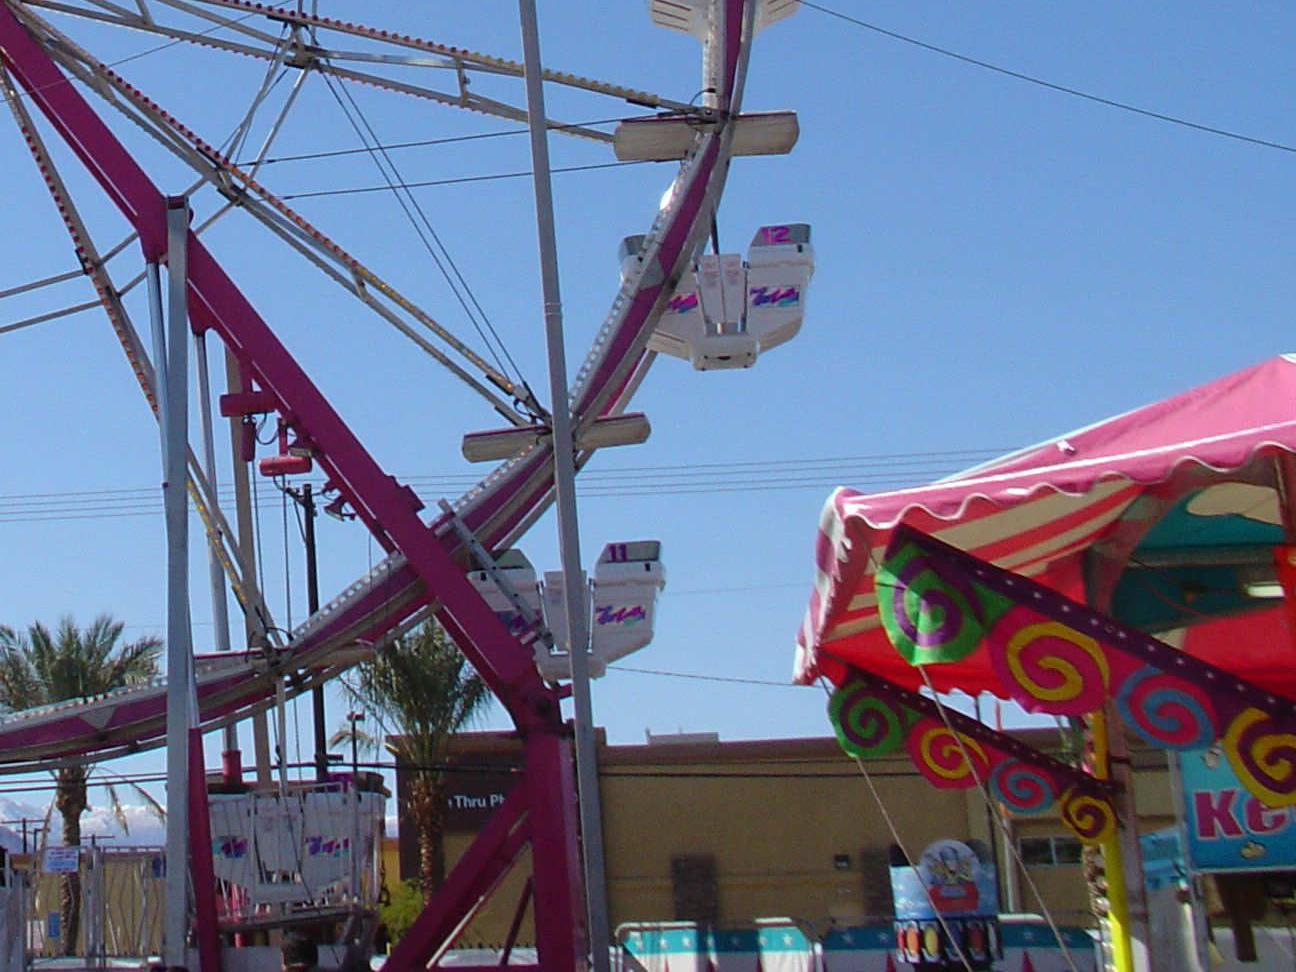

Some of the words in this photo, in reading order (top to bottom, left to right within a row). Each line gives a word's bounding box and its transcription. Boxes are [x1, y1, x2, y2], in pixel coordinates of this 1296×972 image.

[760, 226, 792, 244] 12
[608, 544, 628, 562] 11
[454, 794, 486, 808] Thru
